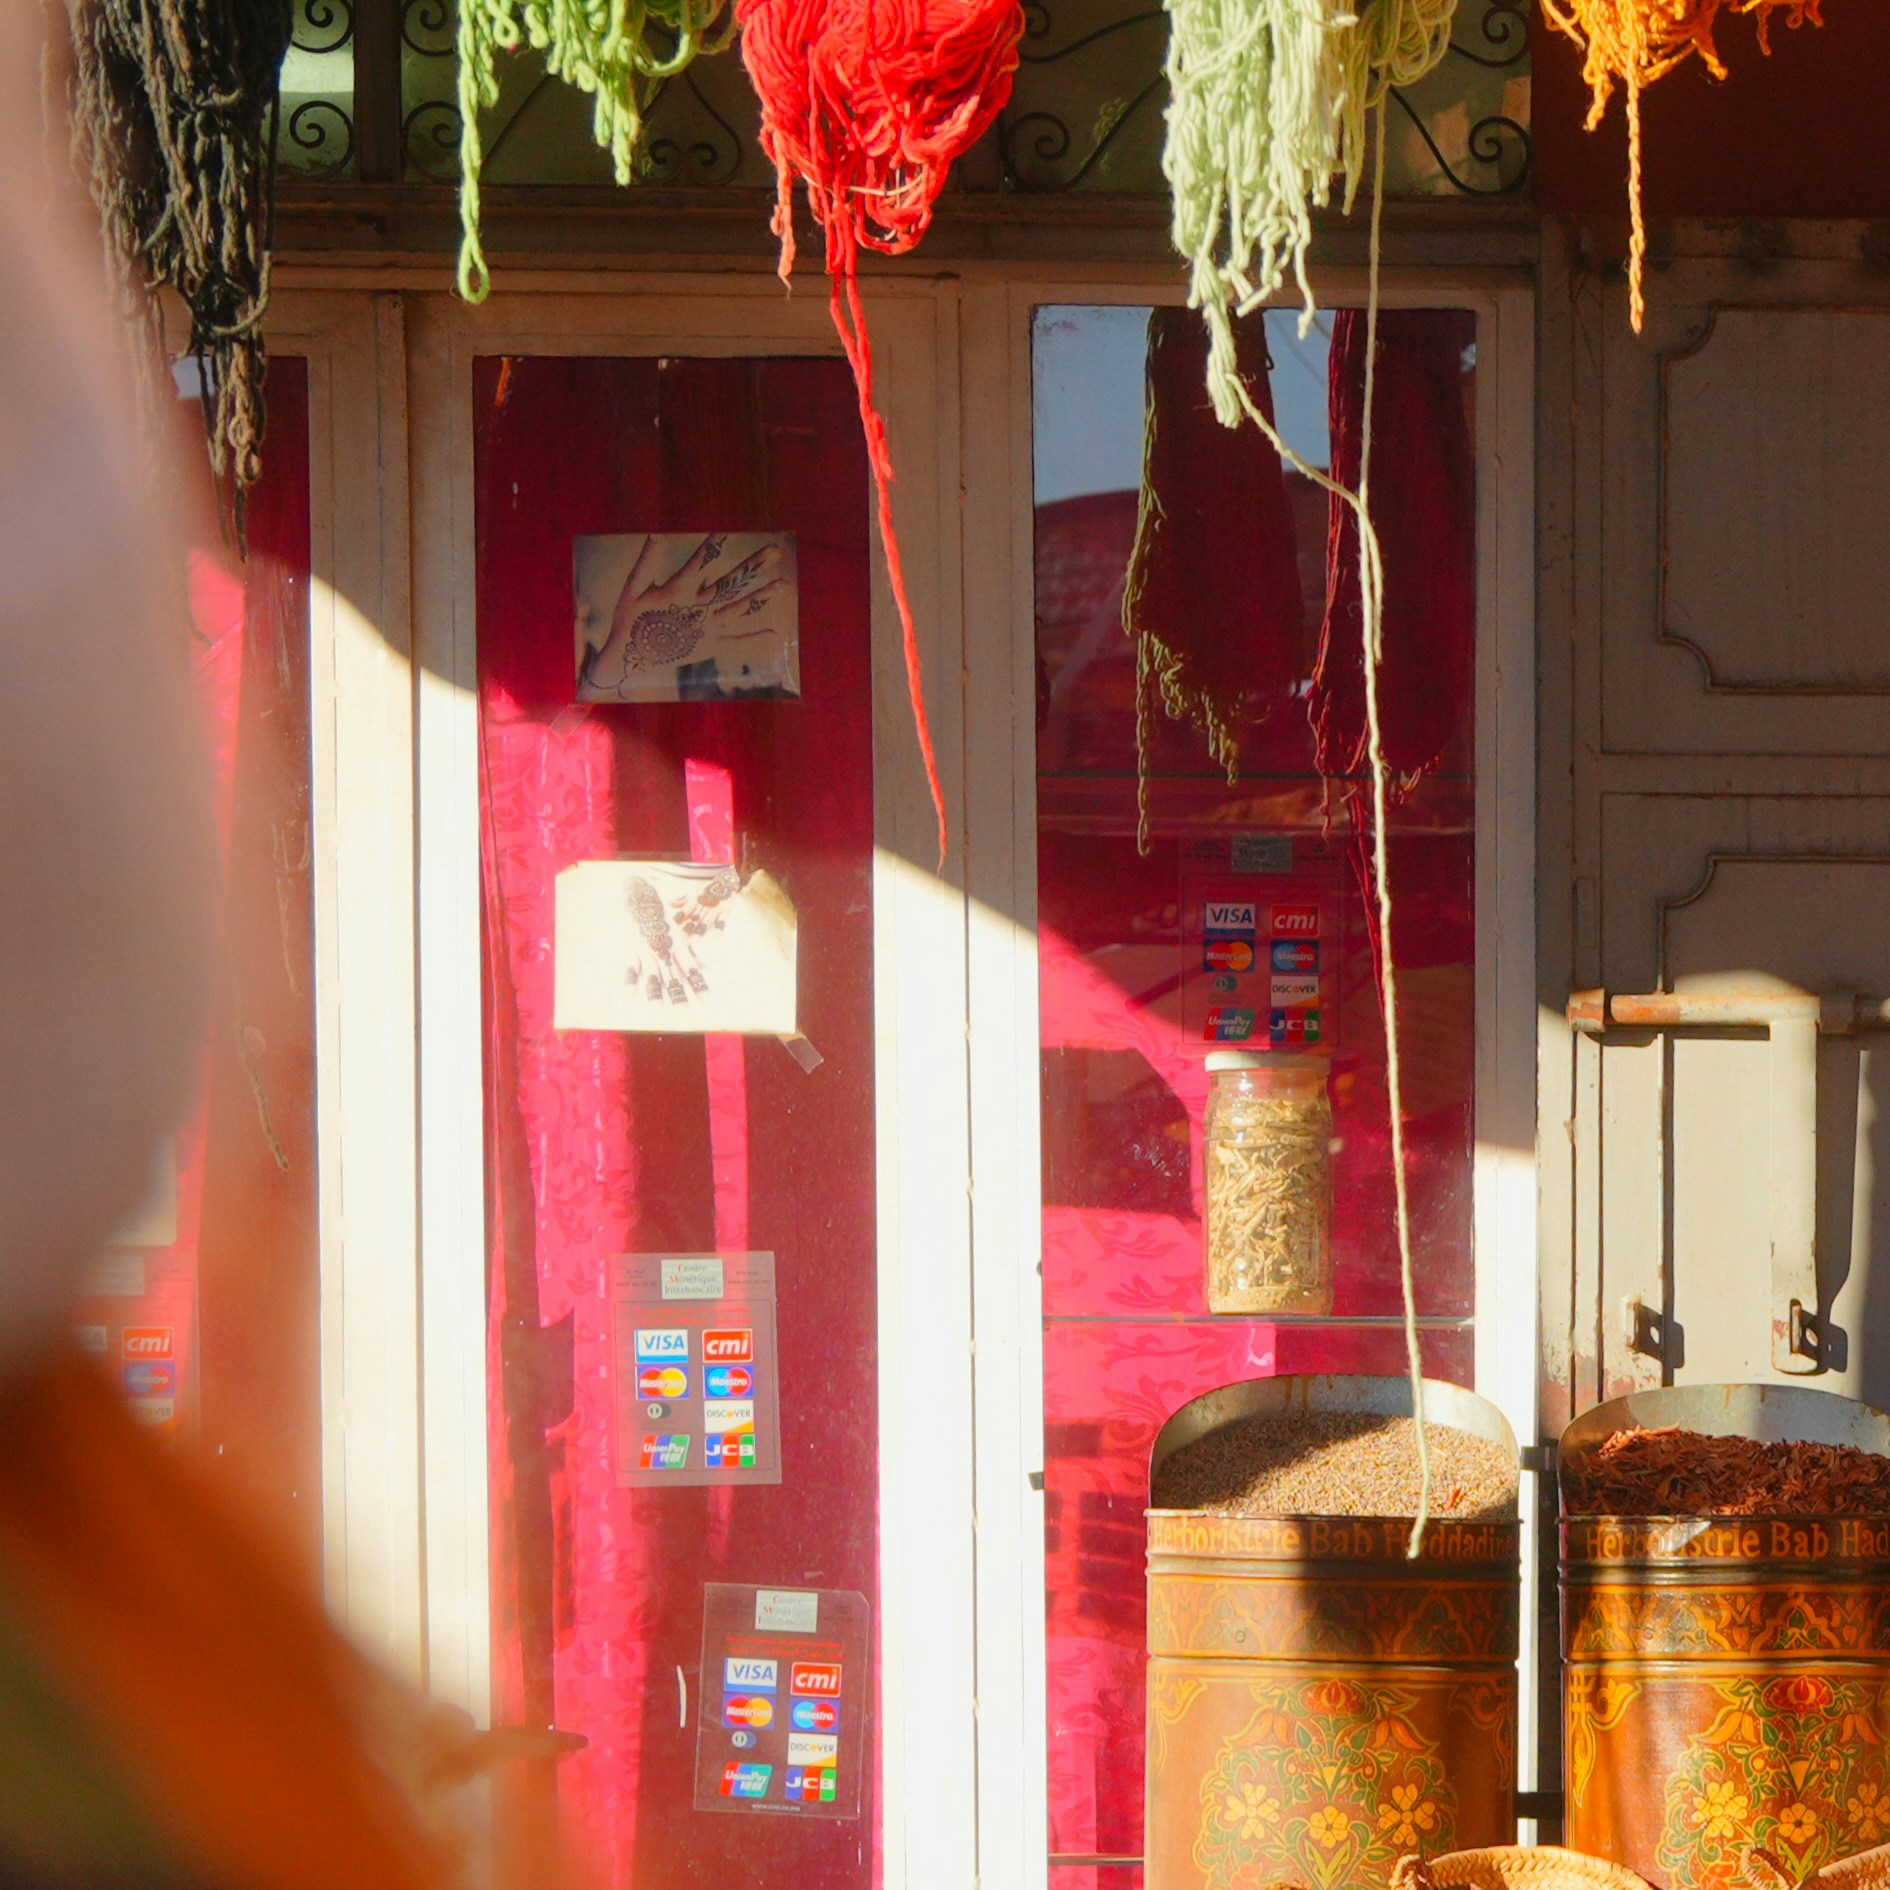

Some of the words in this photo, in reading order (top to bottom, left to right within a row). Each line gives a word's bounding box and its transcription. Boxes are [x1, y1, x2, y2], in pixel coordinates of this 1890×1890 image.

[1210, 908, 1253, 924] VISA
[1274, 909, 1316, 930] cmi
[1272, 984, 1316, 994] DISCOVER
[1270, 1019, 1318, 1031] JCB
[678, 1264, 708, 1273] Centre
[642, 1335, 685, 1350] VISA
[706, 1332, 750, 1355] cmi
[706, 1409, 752, 1419] DISCOVER
[705, 1443, 754, 1457] JCB
[1310, 1521, 1372, 1555] Bab
[1382, 1522, 1514, 1560] Hddadine
[1770, 1520, 1829, 1559] Bab
[732, 1663, 774, 1680] VISA
[795, 1668, 838, 1690] cmi
[790, 1742, 834, 1753] DISCOVER
[785, 1776, 835, 1791] JCB
